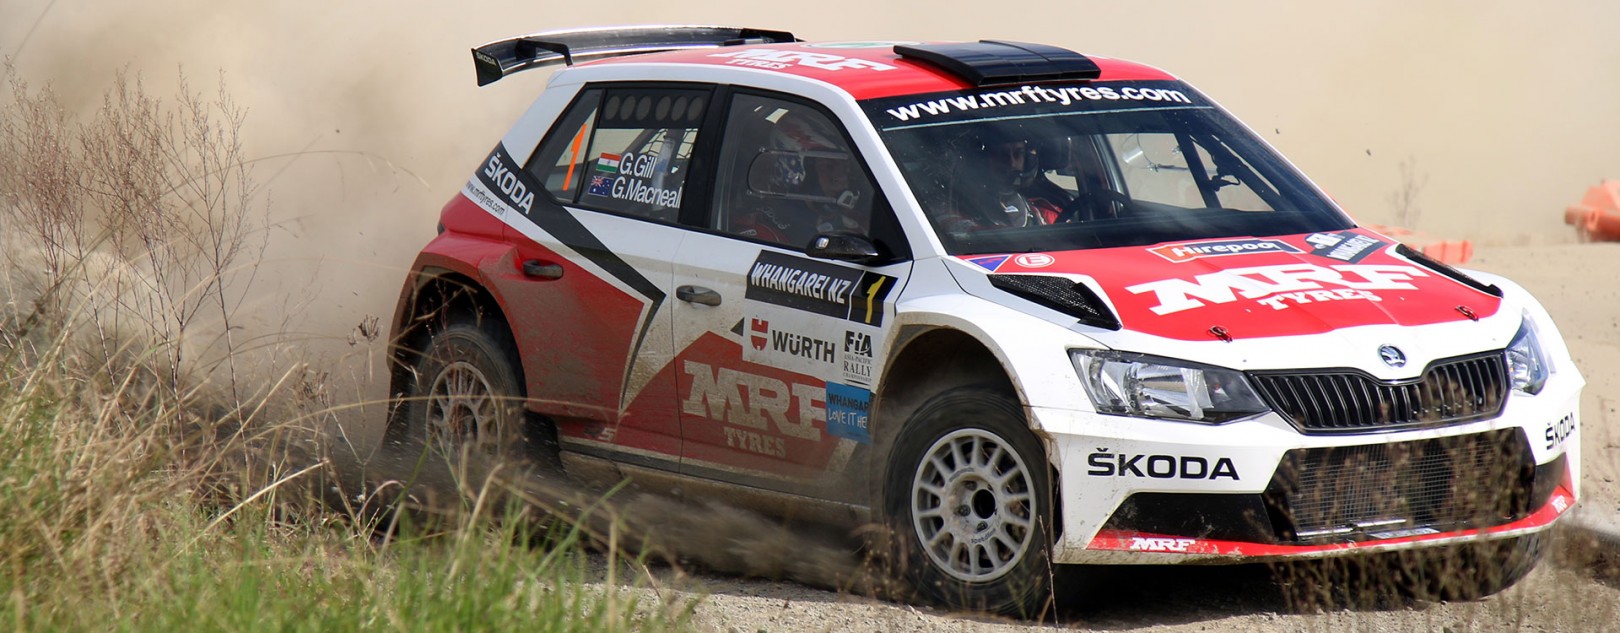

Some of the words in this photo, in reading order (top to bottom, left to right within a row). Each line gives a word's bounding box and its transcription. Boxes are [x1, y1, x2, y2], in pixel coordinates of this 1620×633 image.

[706, 49, 898, 71] MRF
[725, 58, 794, 69] TYRES
[887, 85, 1192, 121] www.mrftyres.com
[563, 124, 587, 191] 1
[619, 152, 657, 179] G.Gill
[484, 152, 535, 215] ŠKODA
[611, 176, 683, 209] G.Macneal
[750, 262, 827, 300] WHANGAREI
[828, 277, 852, 304] NZ
[1125, 264, 1431, 316] MRF
[864, 276, 886, 324] 1
[1257, 289, 1383, 312] TYRES
[843, 361, 873, 378] RALLY
[682, 359, 827, 442] MRF
[847, 412, 857, 426] IT
[1545, 411, 1575, 450] ŠKODA
[723, 426, 785, 458] TYRES
[1087, 447, 1240, 481] ŠKODA
[1131, 536, 1195, 552] MRF
